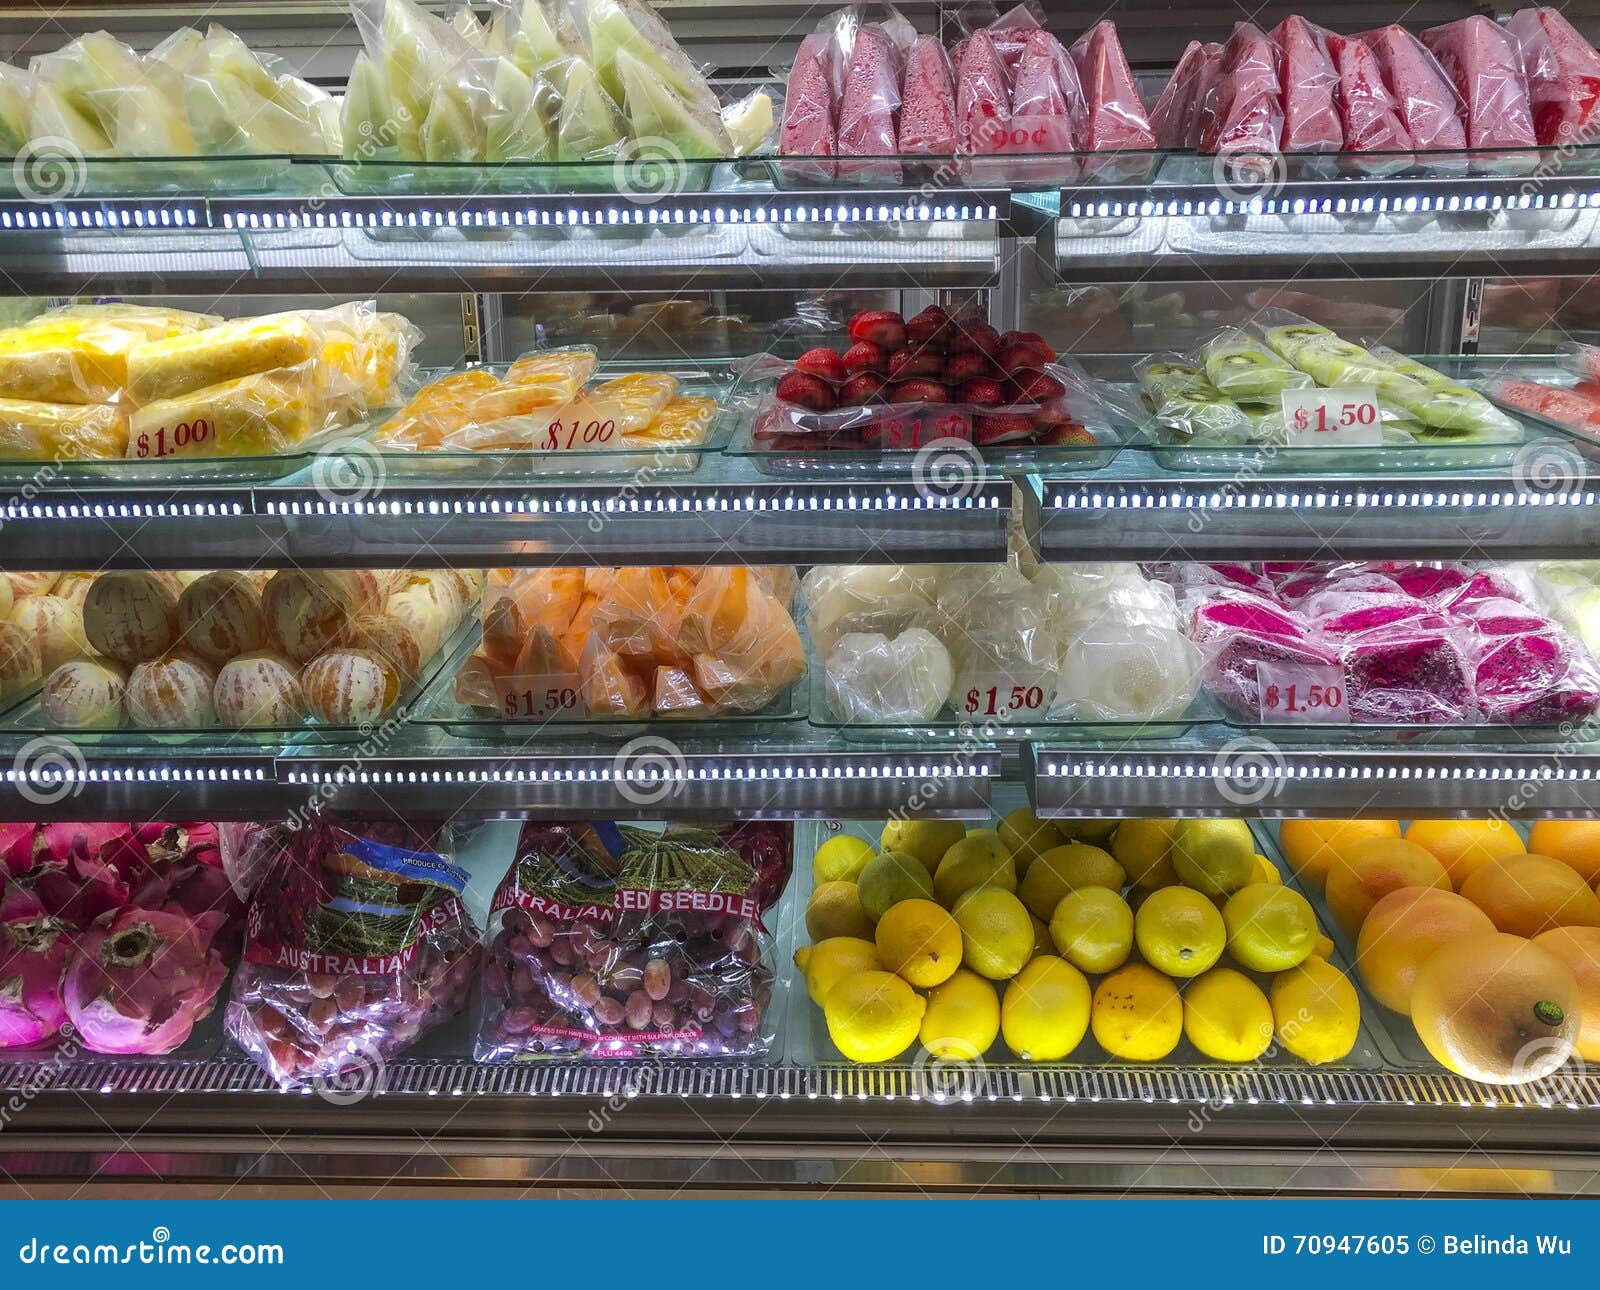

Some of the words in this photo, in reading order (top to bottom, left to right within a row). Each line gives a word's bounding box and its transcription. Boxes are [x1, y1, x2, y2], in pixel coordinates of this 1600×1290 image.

[991, 121, 1047, 150] 90¢
[1294, 403, 1376, 432] $1.50
[136, 417, 208, 458] $1.00
[504, 688, 577, 718] $1.50
[965, 685, 1044, 716] $1.50
[1265, 683, 1342, 712] $1.50
[493, 886, 614, 922] AUSTRALIAN
[660, 892, 760, 919] SEEDLE
[277, 945, 414, 975] AUSTRALIAN
